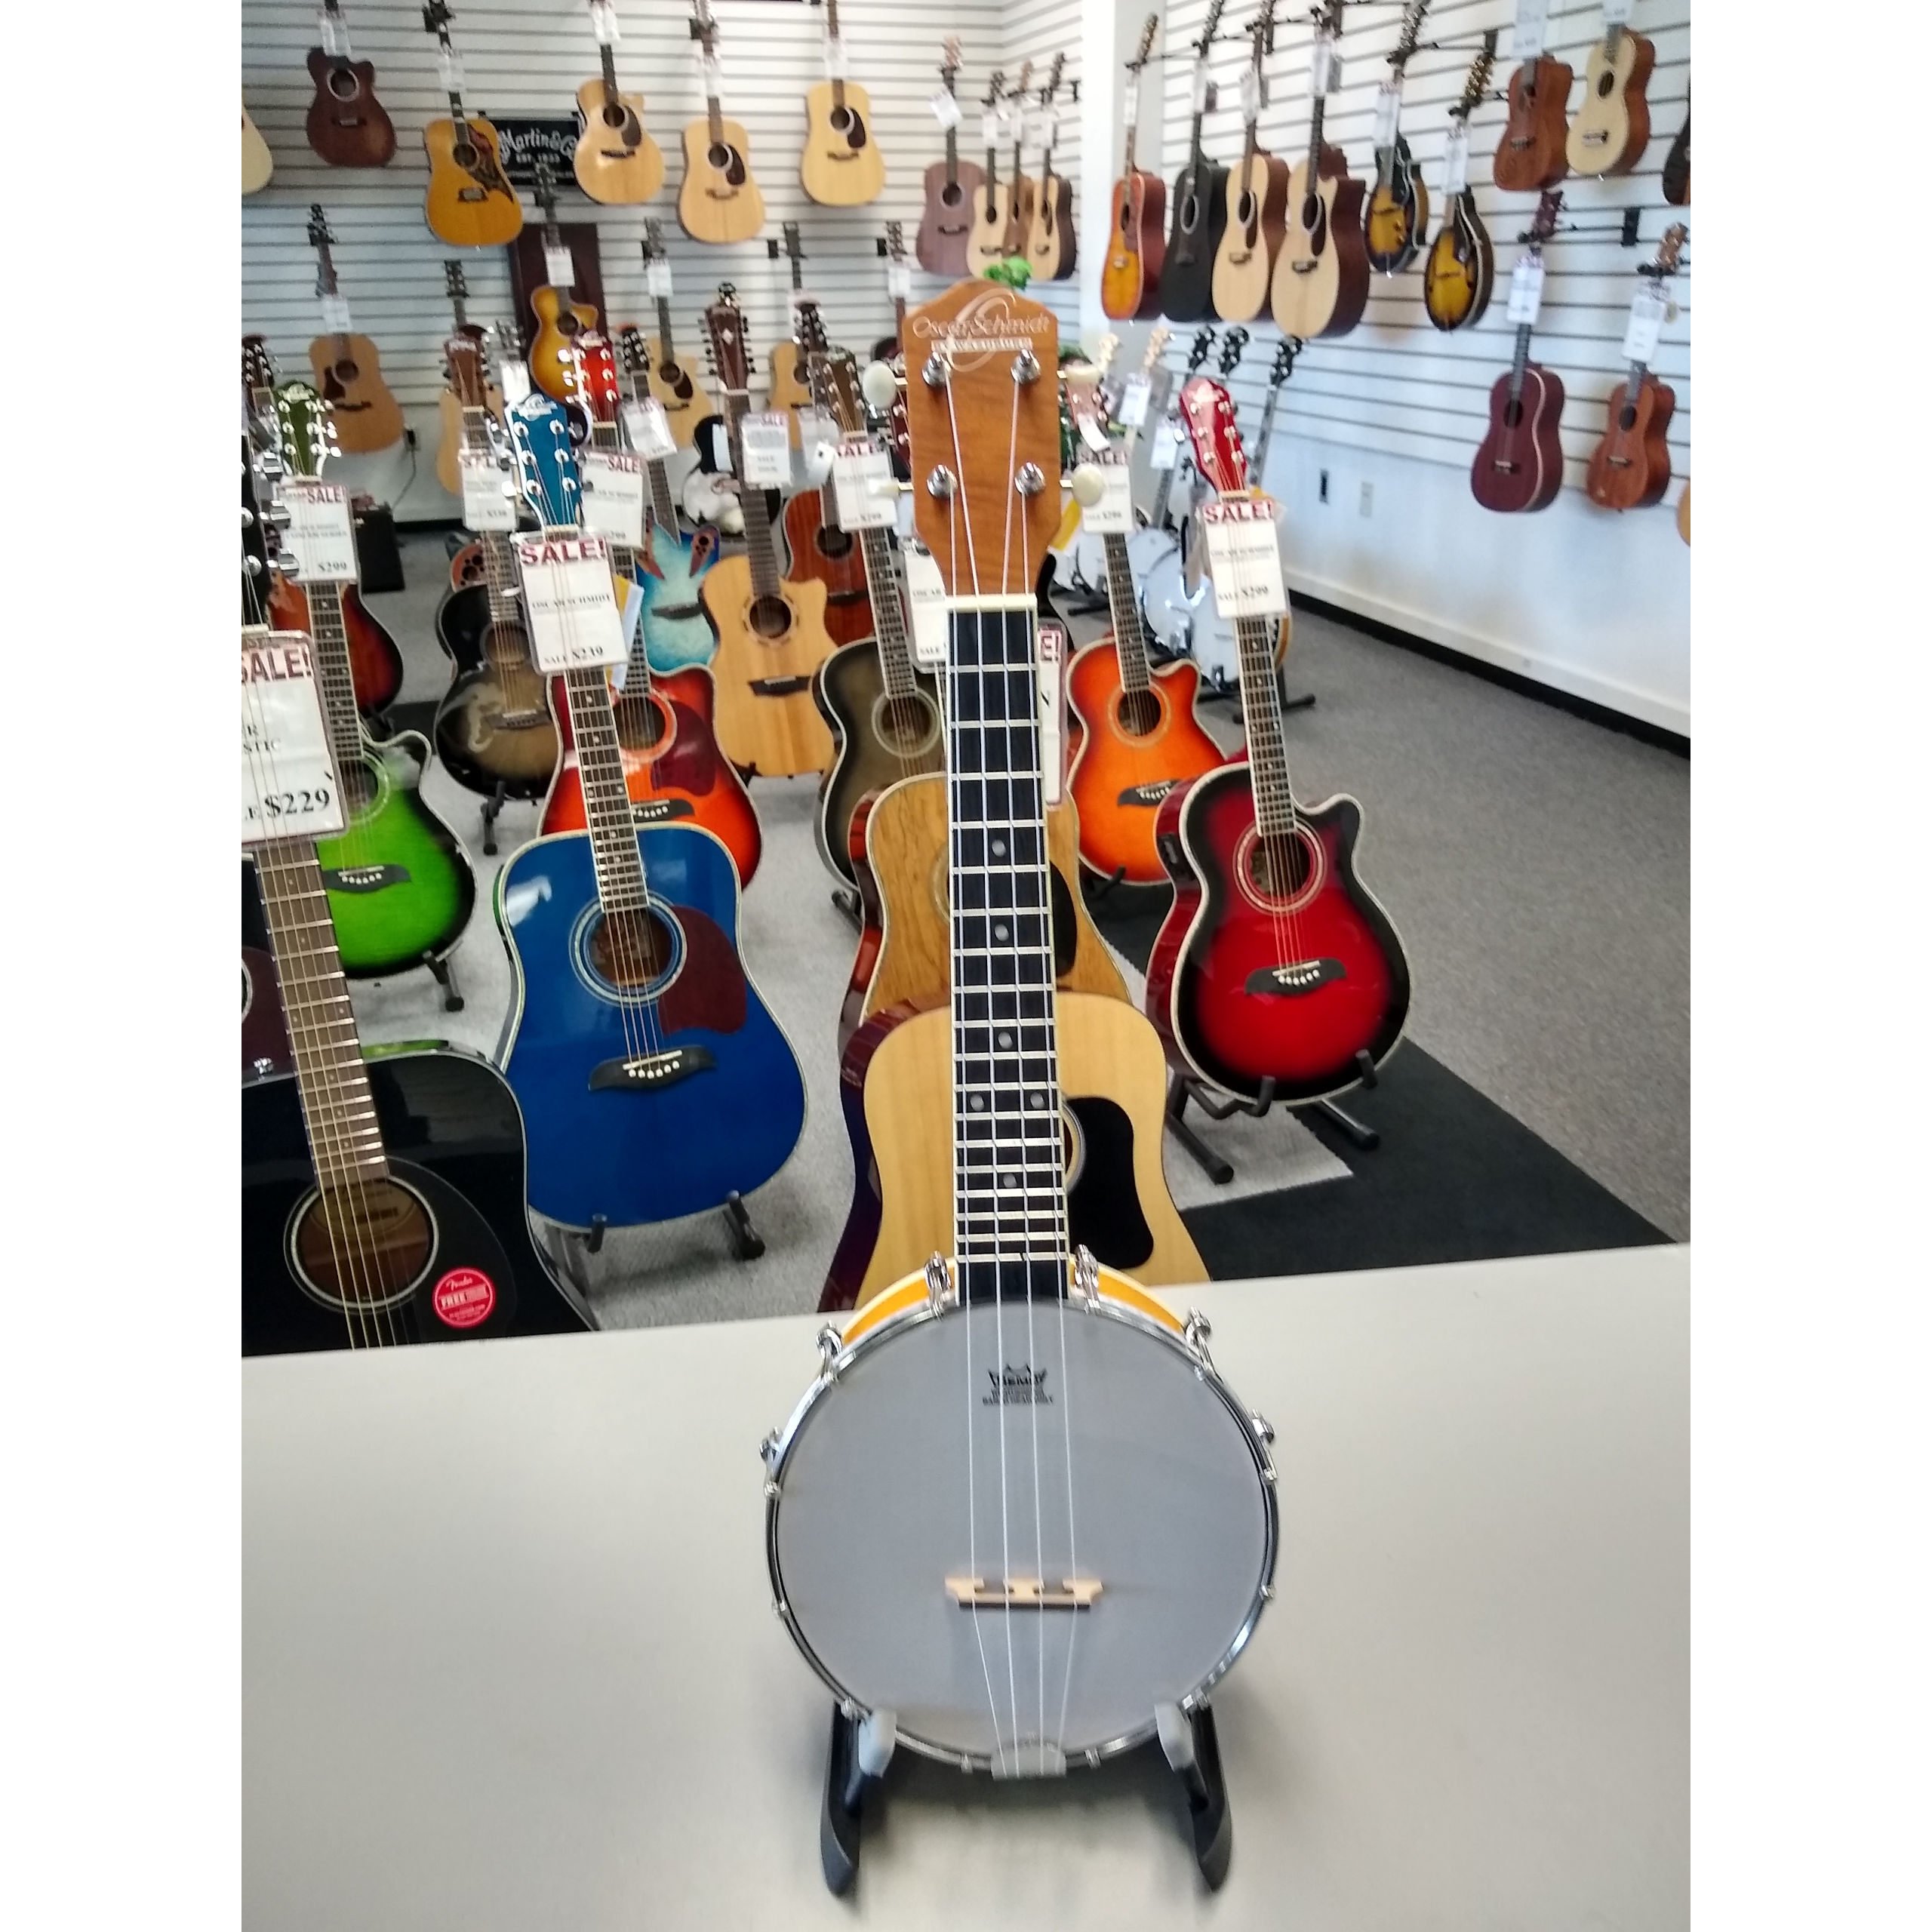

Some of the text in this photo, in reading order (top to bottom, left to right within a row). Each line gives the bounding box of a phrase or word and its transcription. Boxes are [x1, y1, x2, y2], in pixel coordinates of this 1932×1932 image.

[497, 128, 549, 165] Martin
[969, 312, 1050, 338] Schmidt
[1206, 501, 1273, 524] SALE!
[521, 537, 608, 564] SALE!
[264, 787, 331, 820] $229
